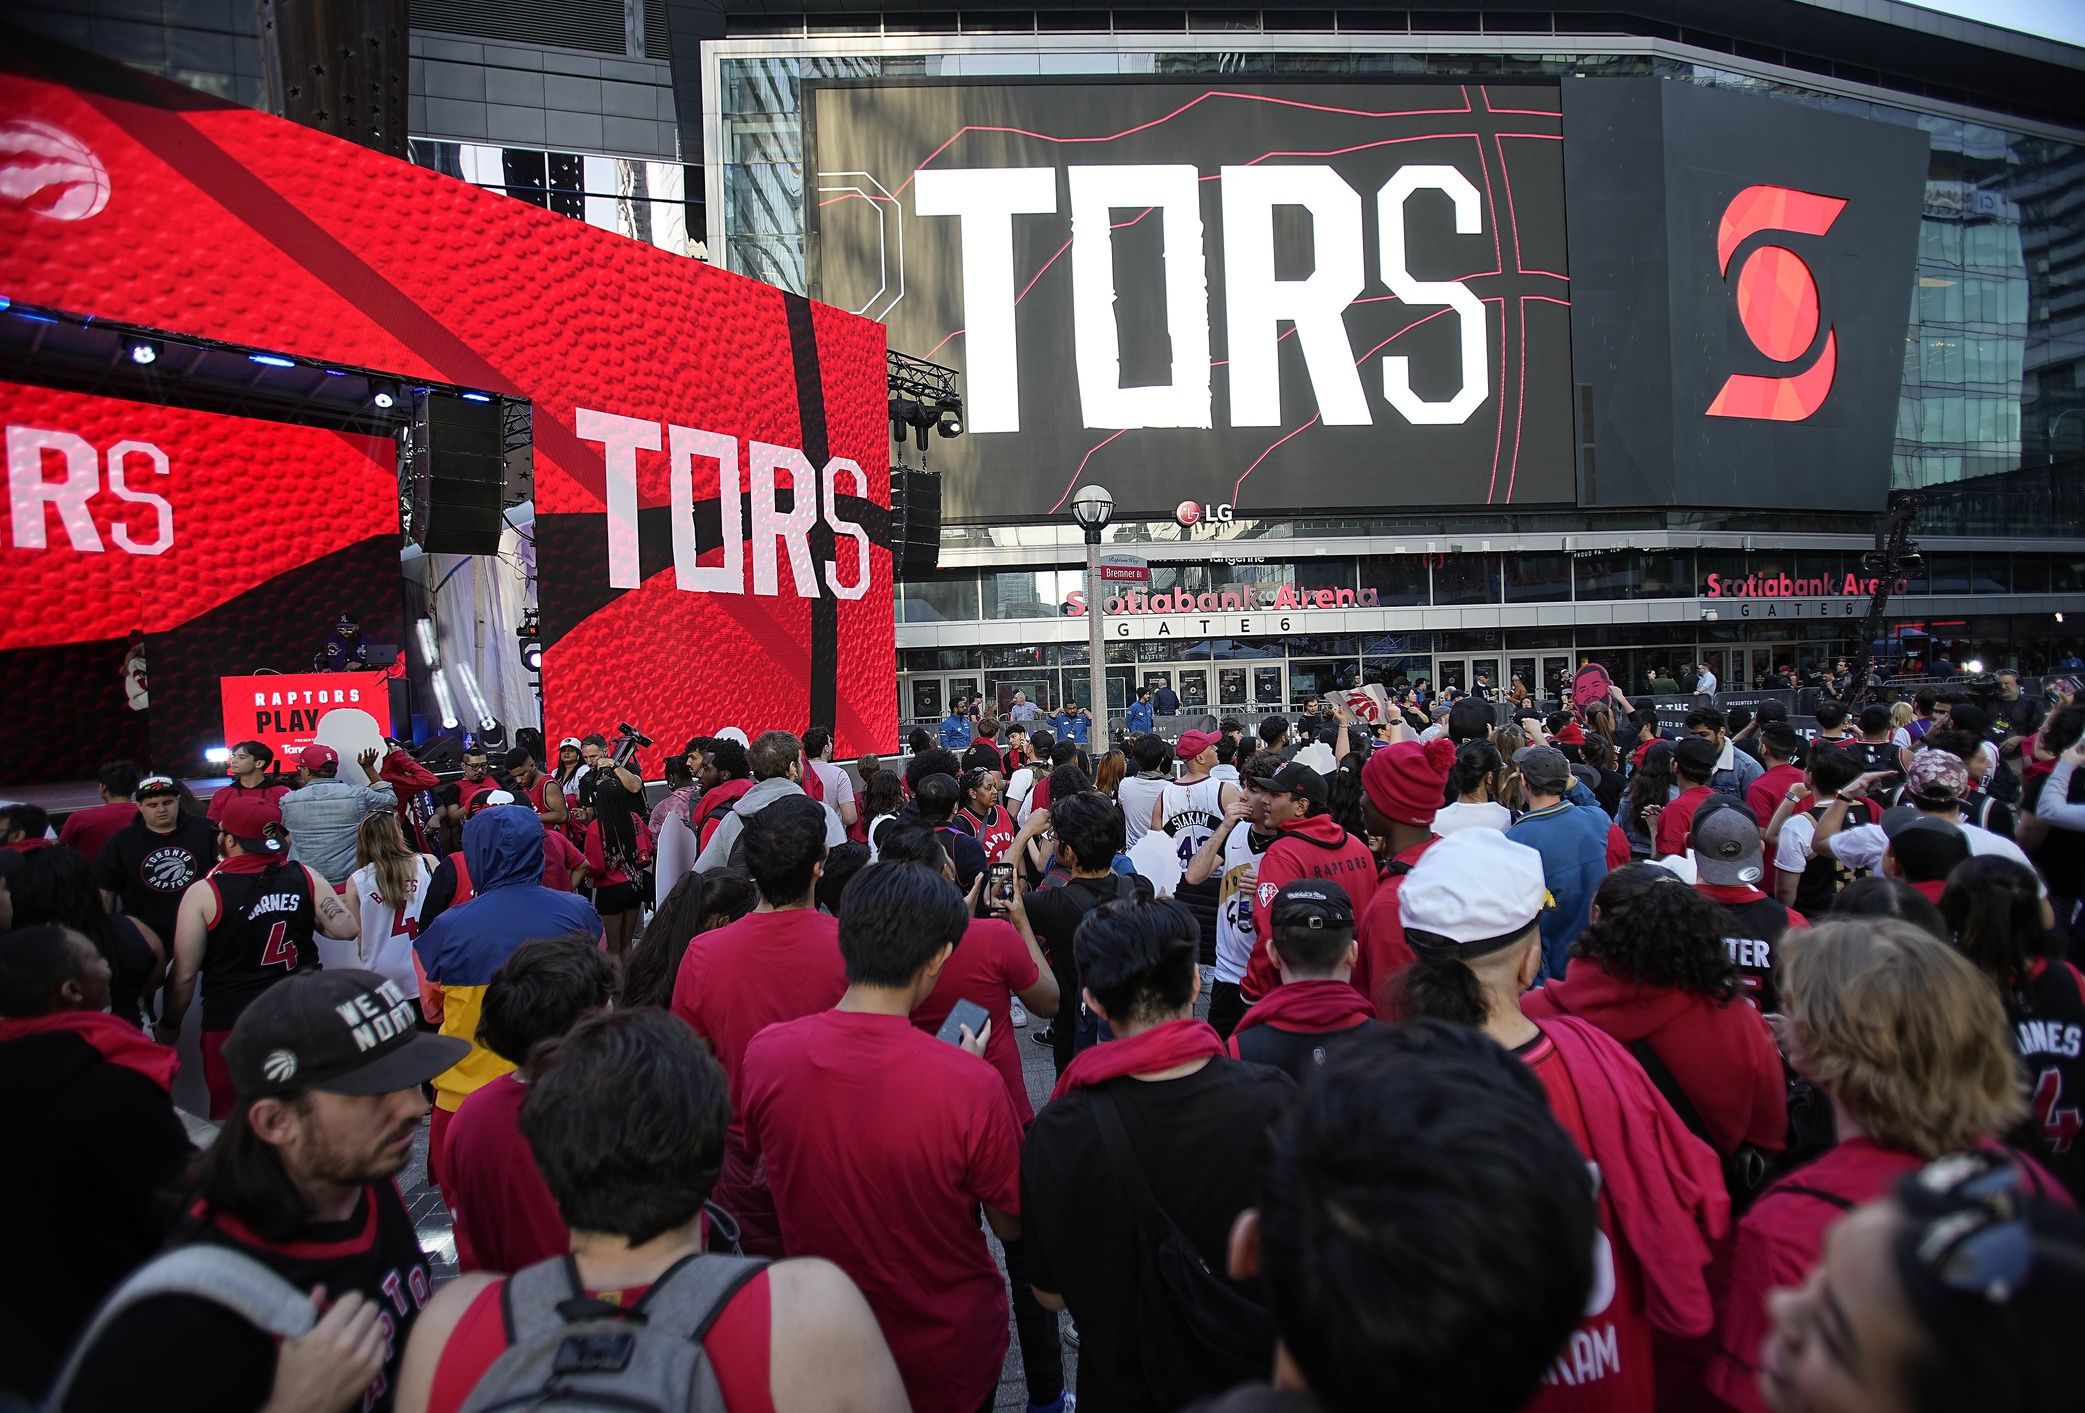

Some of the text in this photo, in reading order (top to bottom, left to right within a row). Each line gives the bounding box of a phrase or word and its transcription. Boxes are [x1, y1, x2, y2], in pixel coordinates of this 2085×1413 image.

[914, 164, 1490, 434] TORS
[5, 424, 175, 556] RS
[575, 406, 871, 601] TORS
[1205, 503, 1233, 521] LG
[1106, 567, 1135, 578] Bremner
[1707, 571, 1908, 597] Scotiabank Area
[1066, 586, 1262, 616] Sotiabank
[1272, 584, 1379, 610] Arena
[1741, 602, 1852, 617] GATE 6
[1117, 617, 1291, 637] GATE 6
[255, 688, 360, 707] RAPTORS
[256, 708, 320, 734] PLAY
[1171, 811, 1210, 831] SIAKAM
[145, 849, 192, 868] TORONTO
[1313, 856, 1368, 878] RAPTORS
[148, 870, 194, 889] RAPTORS
[261, 920, 299, 971] 4
[1724, 937, 1771, 968] TER
[335, 993, 380, 1027] WE
[2034, 1067, 2083, 1152] 4
